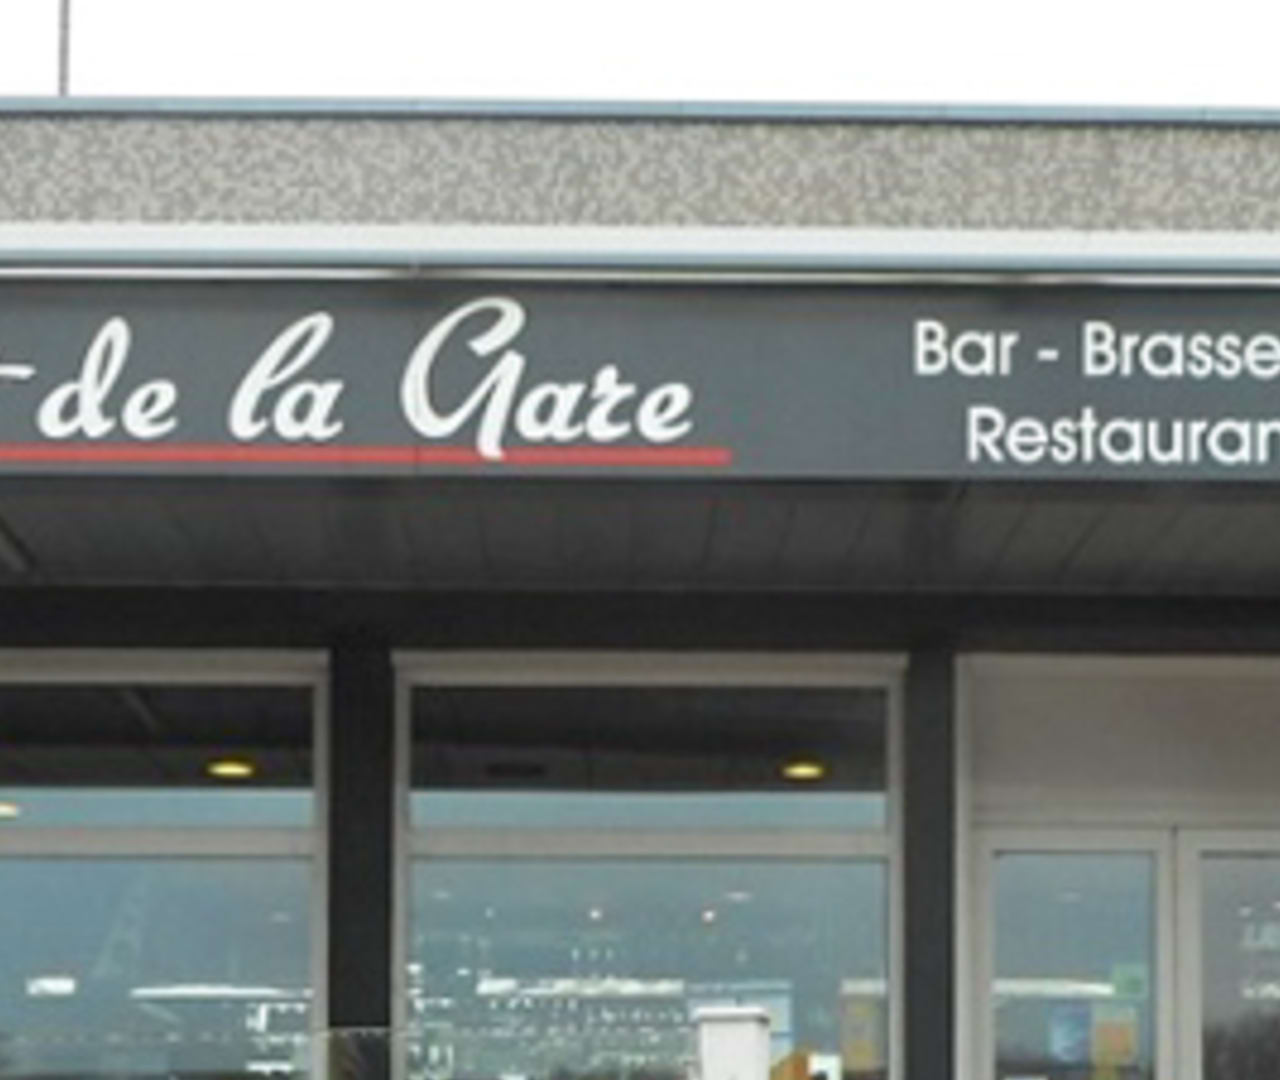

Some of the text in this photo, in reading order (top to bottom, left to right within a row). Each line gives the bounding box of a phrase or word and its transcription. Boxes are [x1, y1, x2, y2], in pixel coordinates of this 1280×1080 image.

[36, 315, 179, 440] de
[228, 310, 345, 441] la
[398, 295, 695, 460] Gare
[913, 319, 1019, 377] Bar
